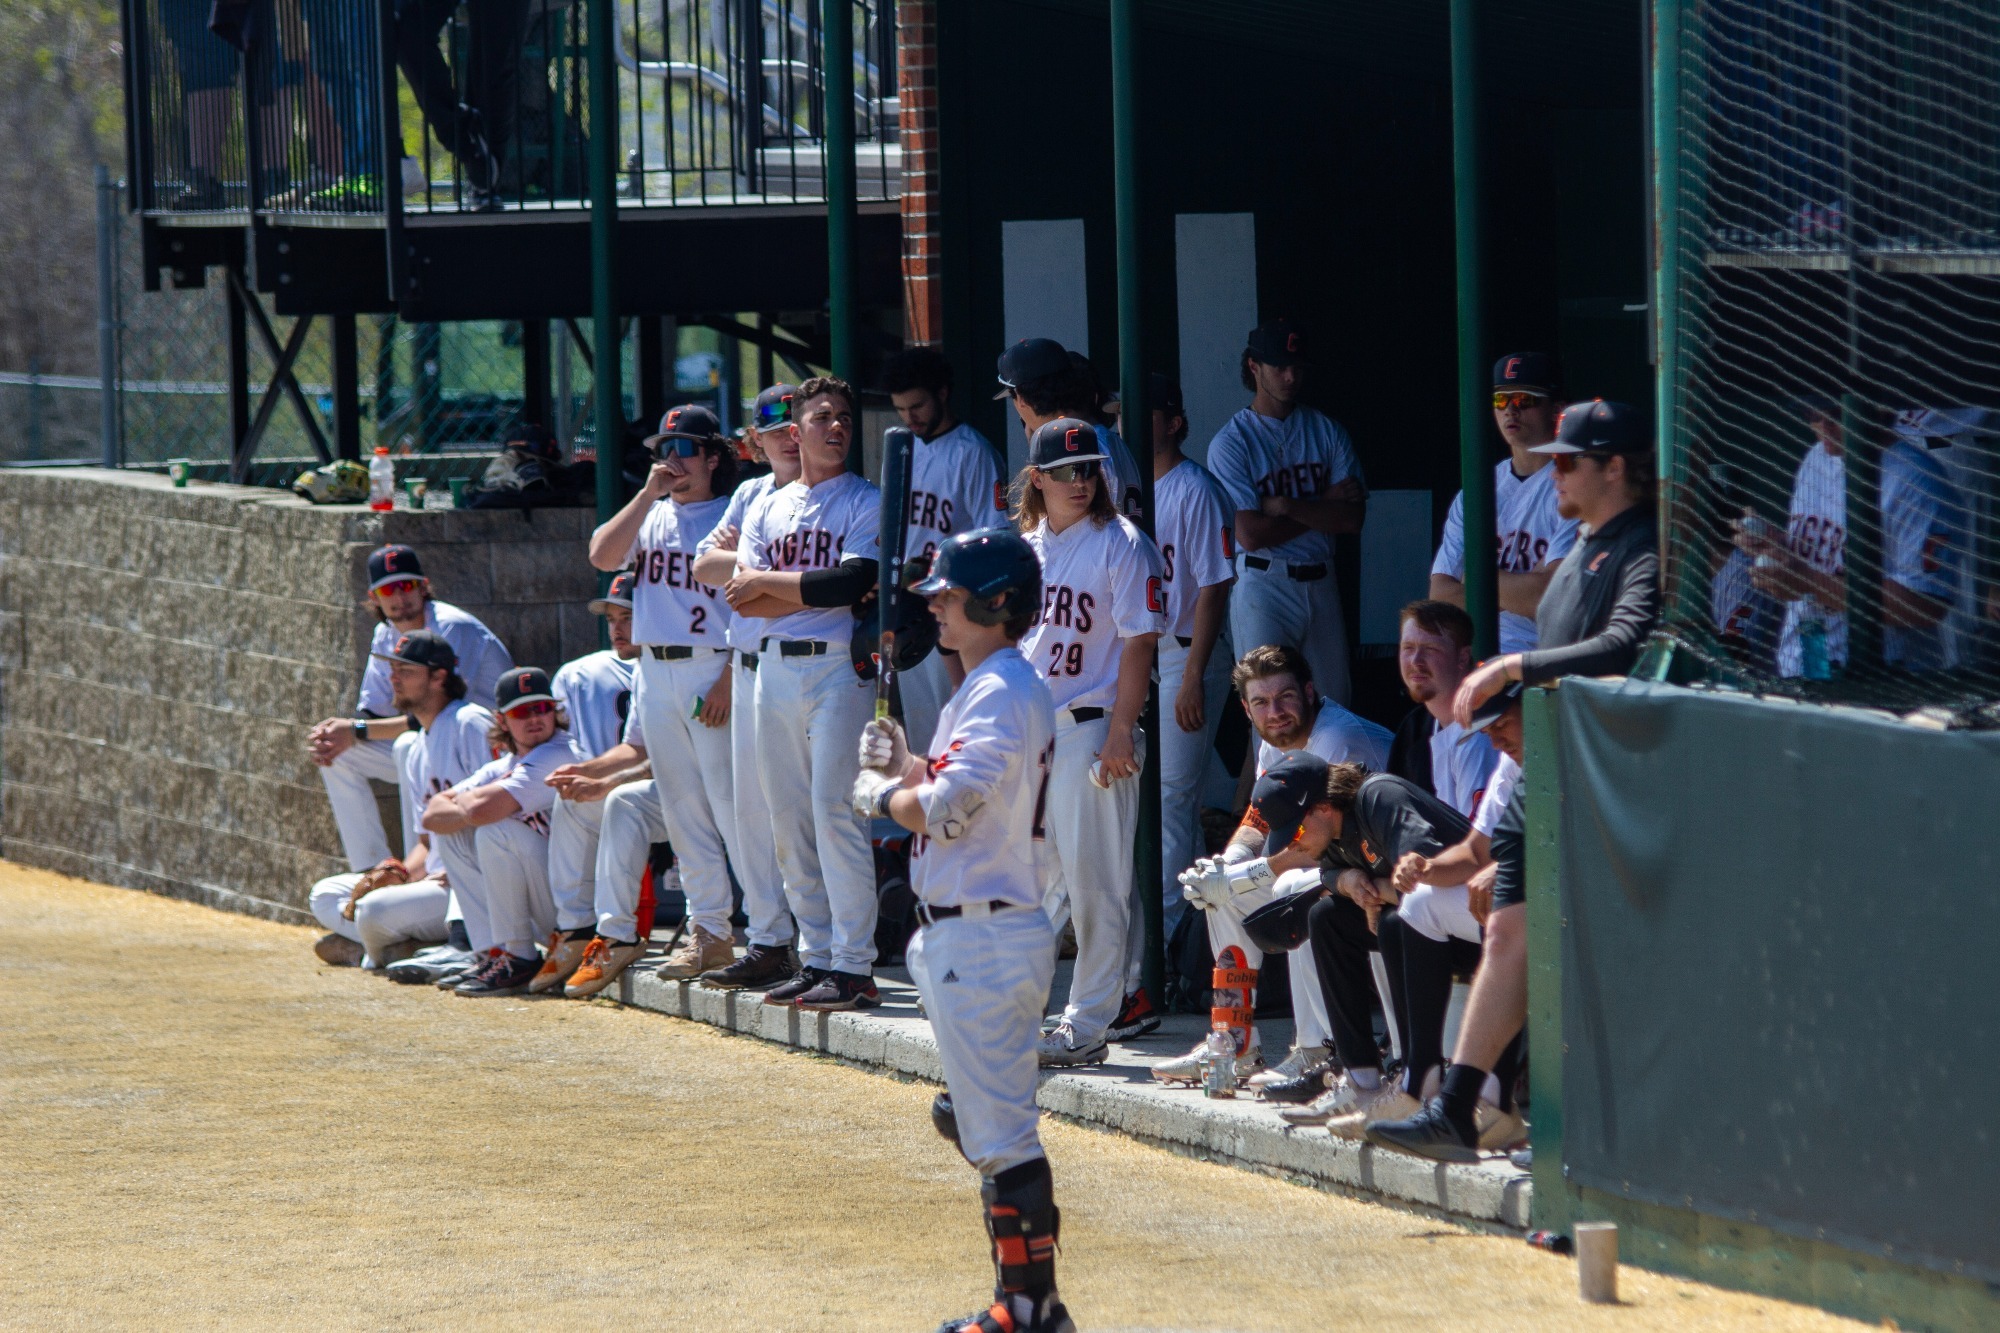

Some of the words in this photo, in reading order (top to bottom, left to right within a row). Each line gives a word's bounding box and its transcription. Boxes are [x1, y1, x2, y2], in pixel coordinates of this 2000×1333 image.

[1503, 357, 1522, 379] C
[665, 411, 681, 430] C
[1065, 429, 1079, 451] C
[1256, 463, 1333, 499] TIGER
[909, 488, 954, 535] ERS
[384, 551, 398, 572] C
[610, 577, 625, 595] C
[1146, 575, 1162, 613] C
[689, 605, 707, 635] 2
[1031, 584, 1095, 634] ERS
[1048, 642, 1084, 677] 29
[517, 672, 532, 694] C
